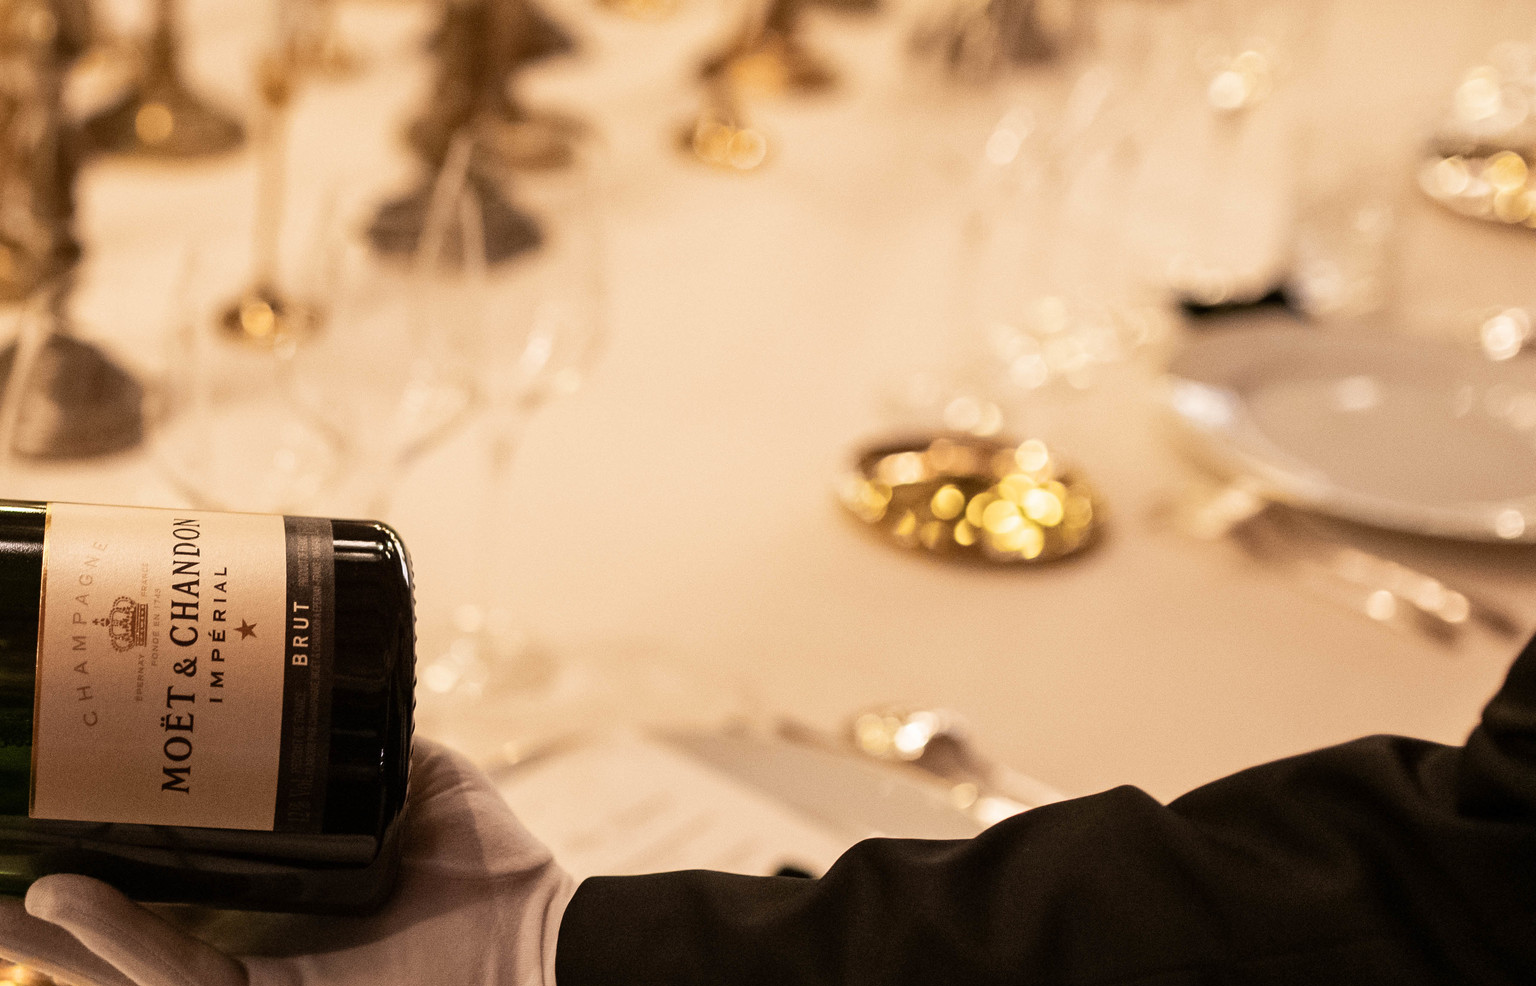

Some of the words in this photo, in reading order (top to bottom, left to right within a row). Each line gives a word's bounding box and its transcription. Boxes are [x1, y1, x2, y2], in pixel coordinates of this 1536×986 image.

[71, 540, 109, 728] CHAMPAGNE
[168, 517, 201, 648] CHANDON
[208, 566, 228, 704] IMPÉRIAL
[290, 600, 310, 667] BRUT
[172, 655, 199, 679] &
[160, 685, 197, 796] MOËT
